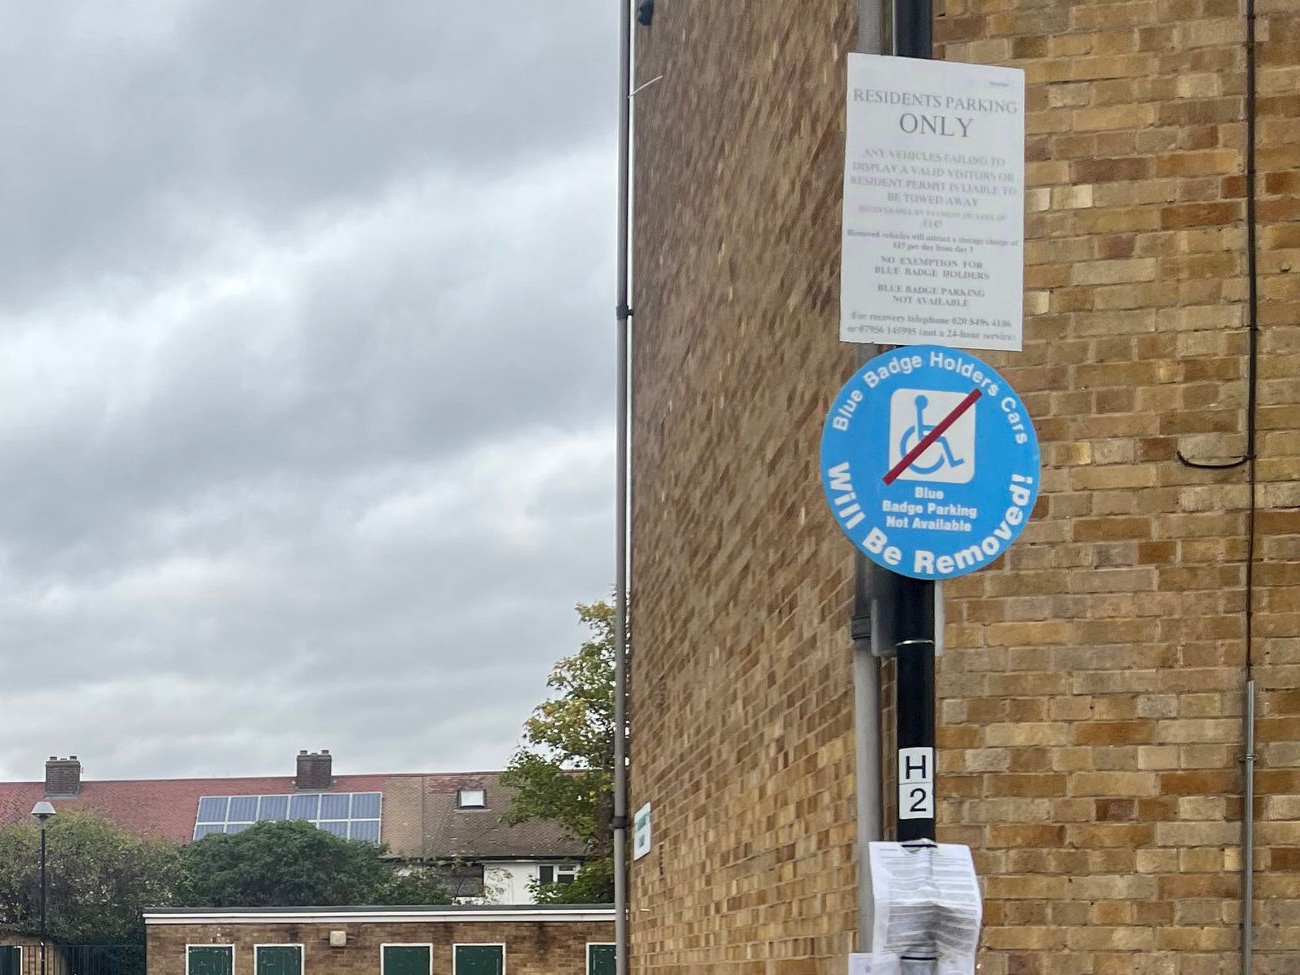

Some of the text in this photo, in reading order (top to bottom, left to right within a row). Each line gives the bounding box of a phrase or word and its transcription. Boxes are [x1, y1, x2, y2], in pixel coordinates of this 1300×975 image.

[854, 88, 1018, 114] RESIDENTS PARKING
[900, 112, 973, 138] ONLY
[864, 148, 1006, 166] ANY VEHICLES FAILING TO
[852, 162, 1014, 182] DISPLAY A VALID VISITORS OR
[850, 176, 1017, 196] RESIDENT PERMIT IS LIABLE TO
[886, 192, 978, 207] BE TOWED AWAY
[848, 229, 880, 238] Removed
[882, 230, 910, 240] vehicles
[912, 232, 924, 240] will
[880, 256, 984, 269] NO EXEMPTION FOR
[874, 266, 990, 280] BLUE BADGE HOLDERS
[878, 284, 985, 298] BLUE BADGE PARKING
[892, 295, 970, 307] NOT AVAILABLE
[908, 315, 950, 326] telephone
[946, 329, 981, 339] 24-hour
[832, 352, 1028, 445] Blue Badge Holders Cars
[914, 486, 944, 500] Blue
[828, 462, 1034, 575] Will Be Removed!
[882, 500, 978, 520] Badge Parking
[886, 515, 972, 532] Not Available
[906, 755, 926, 779] H
[910, 788, 926, 812] 2
